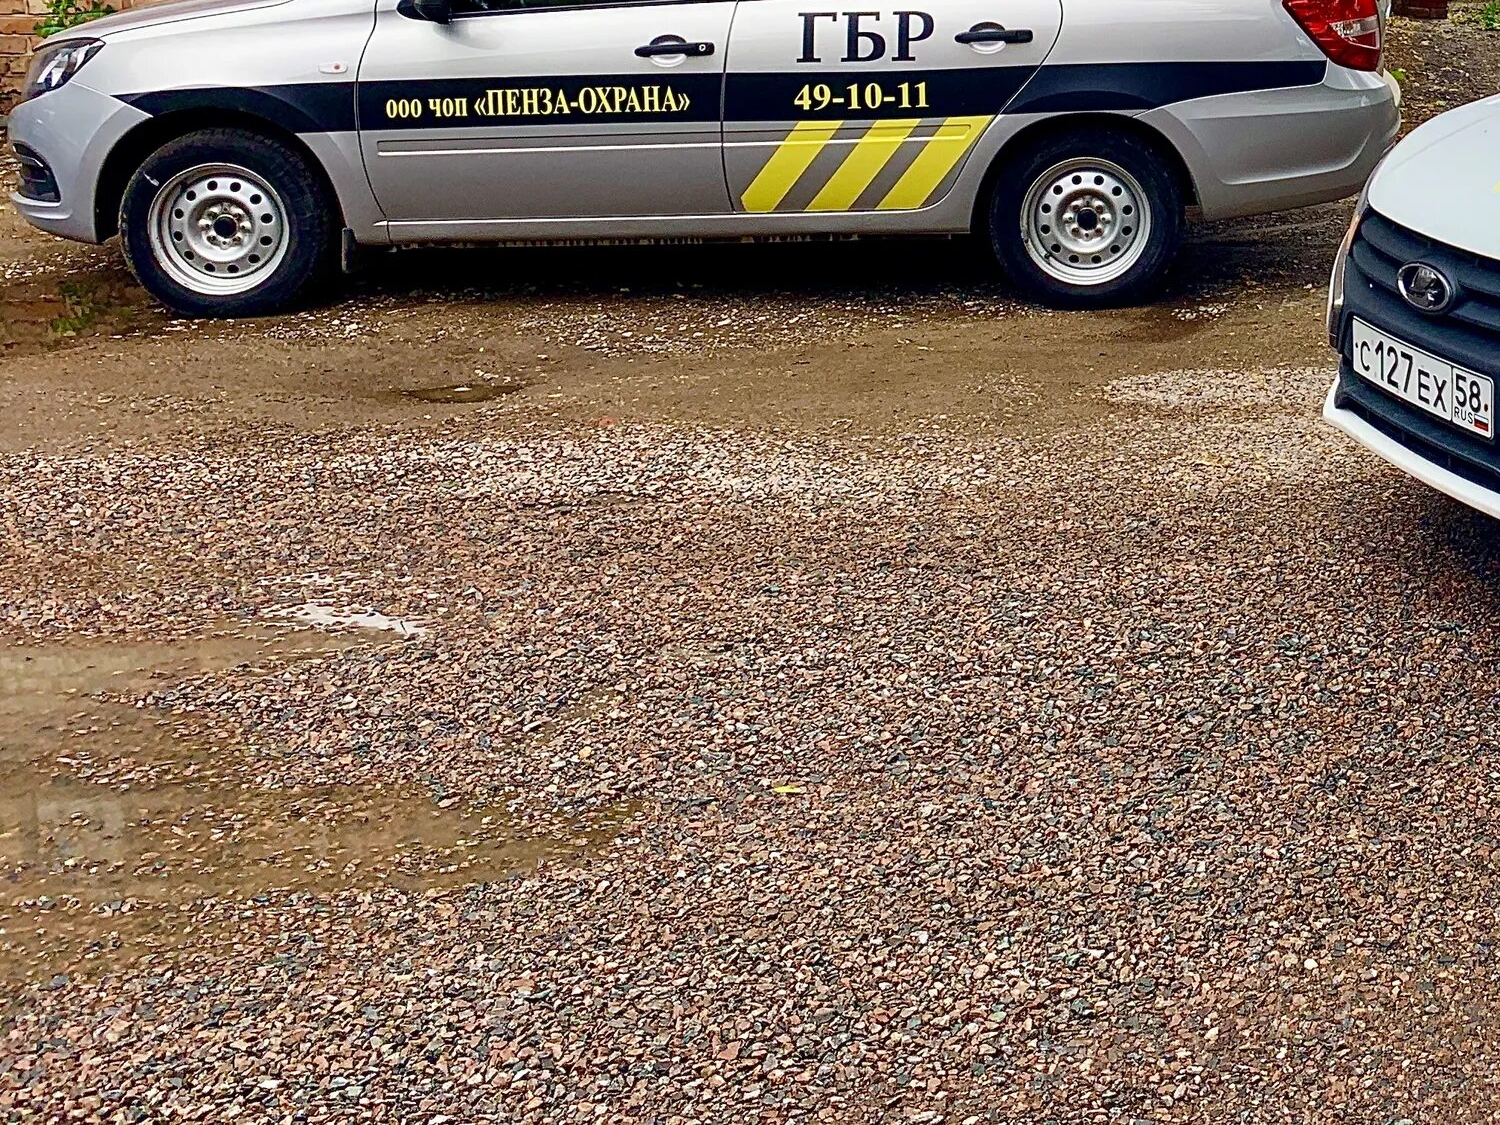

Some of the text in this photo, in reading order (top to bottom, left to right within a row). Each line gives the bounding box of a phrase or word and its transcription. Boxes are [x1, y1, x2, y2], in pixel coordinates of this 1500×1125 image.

[796, 11, 935, 63] ГБР
[385, 85, 691, 119] ООО ЧОП «ПЕНЗА-ОХРАНА»
[793, 81, 930, 111] 49-10-11
[1455, 373, 1482, 414] 58
[1453, 406, 1474, 425] RUS
